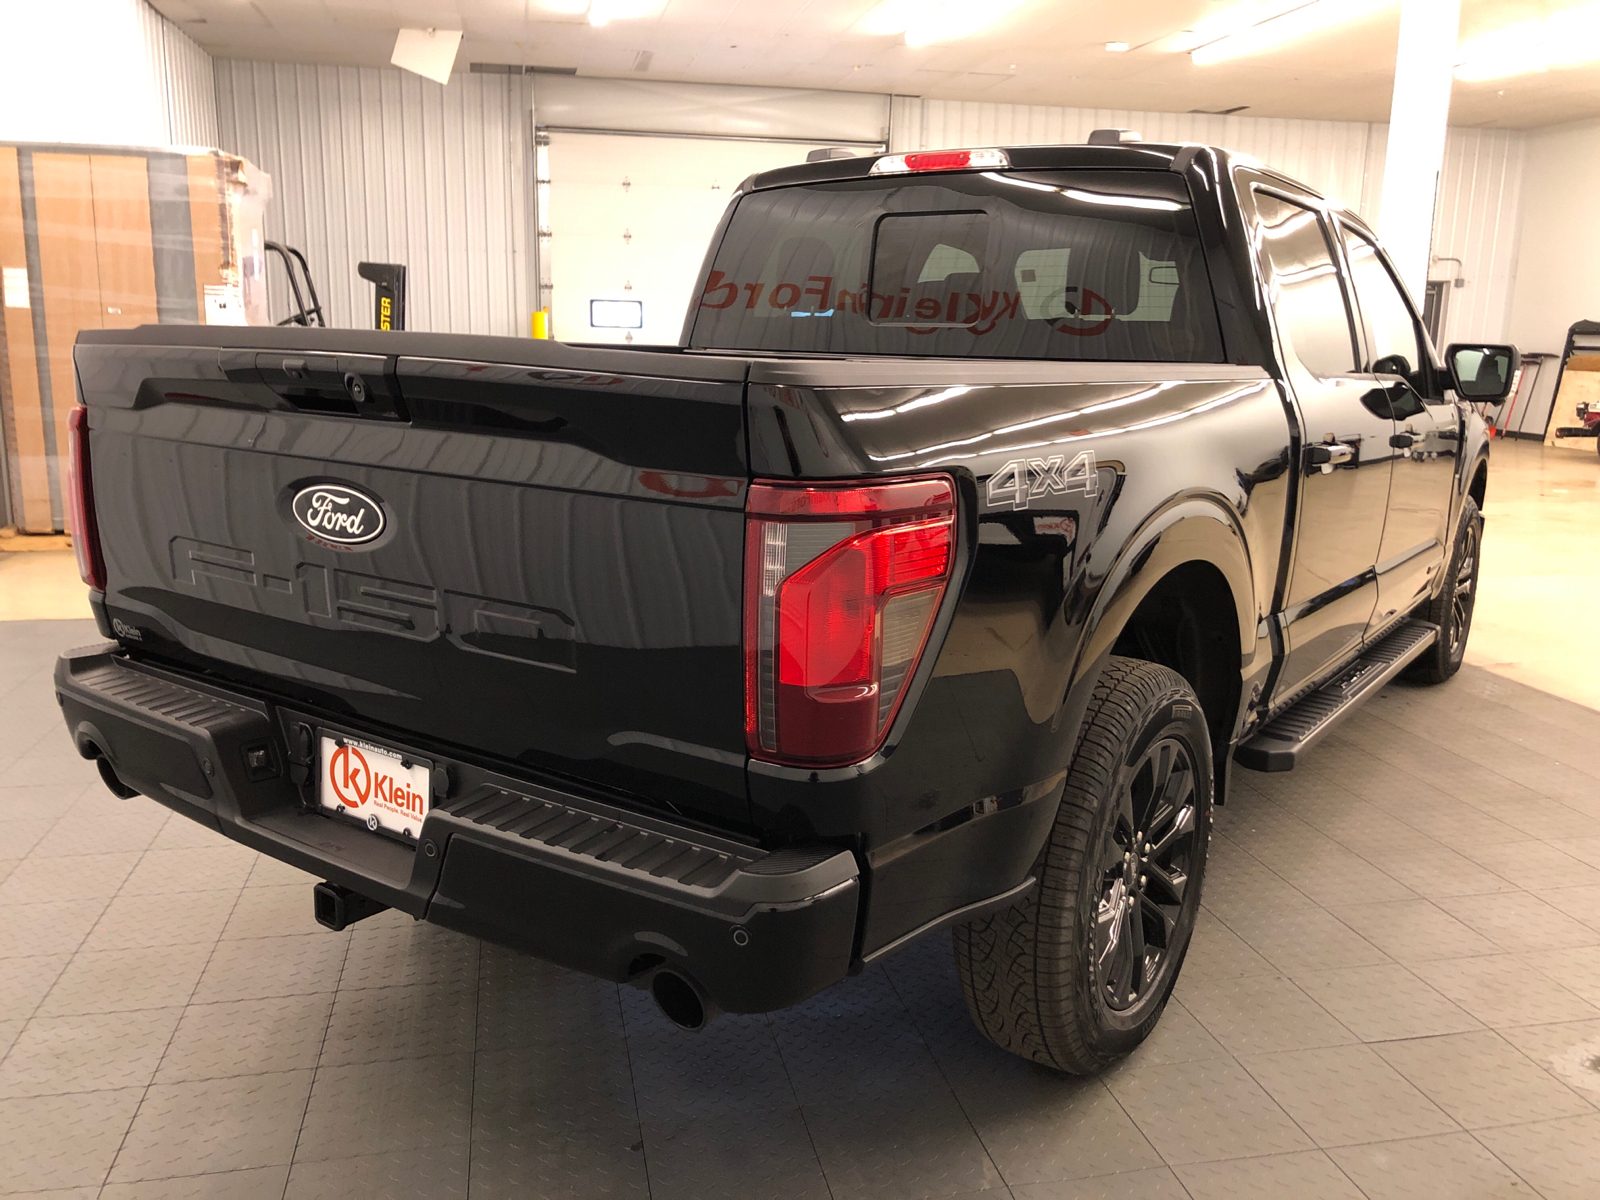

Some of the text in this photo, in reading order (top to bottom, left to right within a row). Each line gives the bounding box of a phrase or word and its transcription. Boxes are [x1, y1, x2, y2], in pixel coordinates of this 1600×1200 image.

[307, 492, 365, 534] Ford
[169, 536, 577, 674] F-150
[343, 737, 403, 761] www.kleinauto.com
[374, 772, 423, 815] Klein
[374, 799, 384, 808] Real
[400, 809, 410, 818] Real
